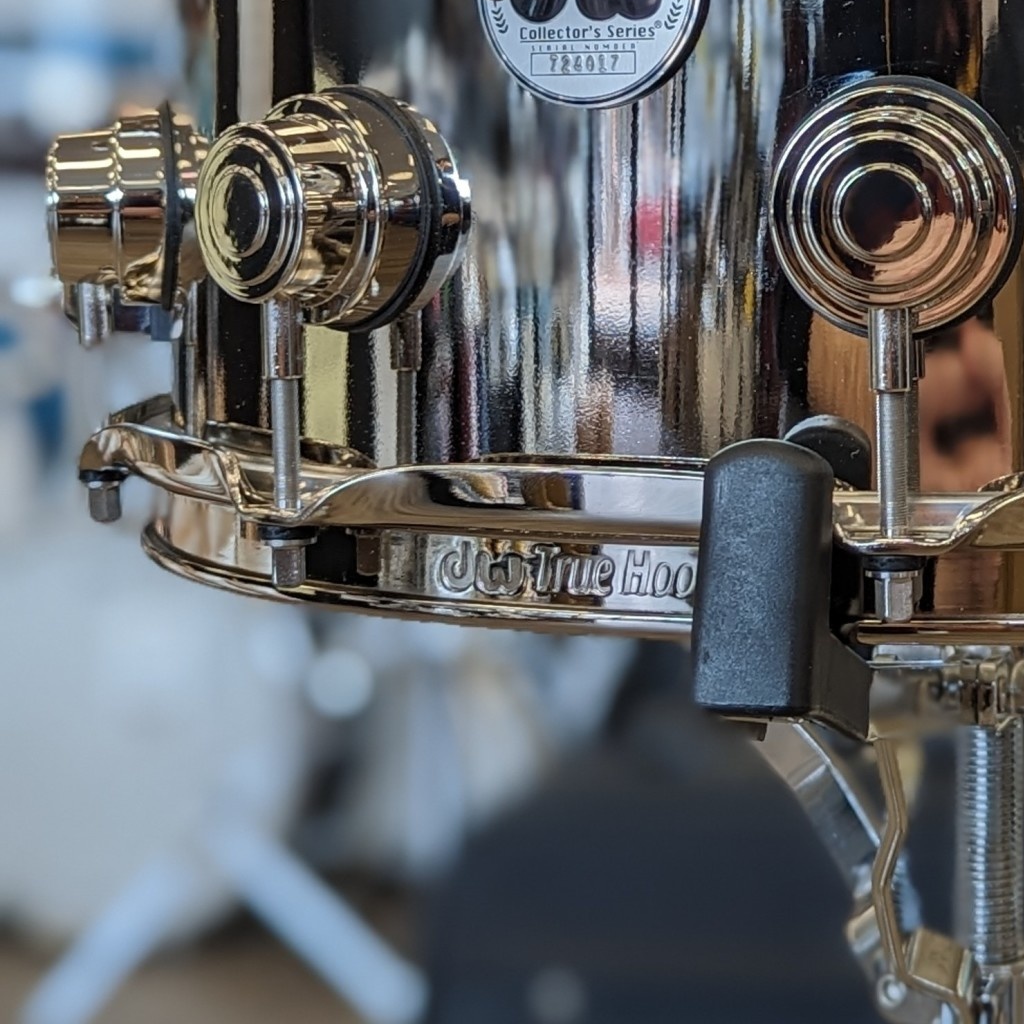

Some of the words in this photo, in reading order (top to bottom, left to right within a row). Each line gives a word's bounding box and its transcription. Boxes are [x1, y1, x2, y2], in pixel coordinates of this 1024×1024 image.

[520, 25, 601, 40] Collector's
[440, 539, 526, 596] dw
[531, 542, 616, 598] True
[621, 549, 696, 599] Hoo
